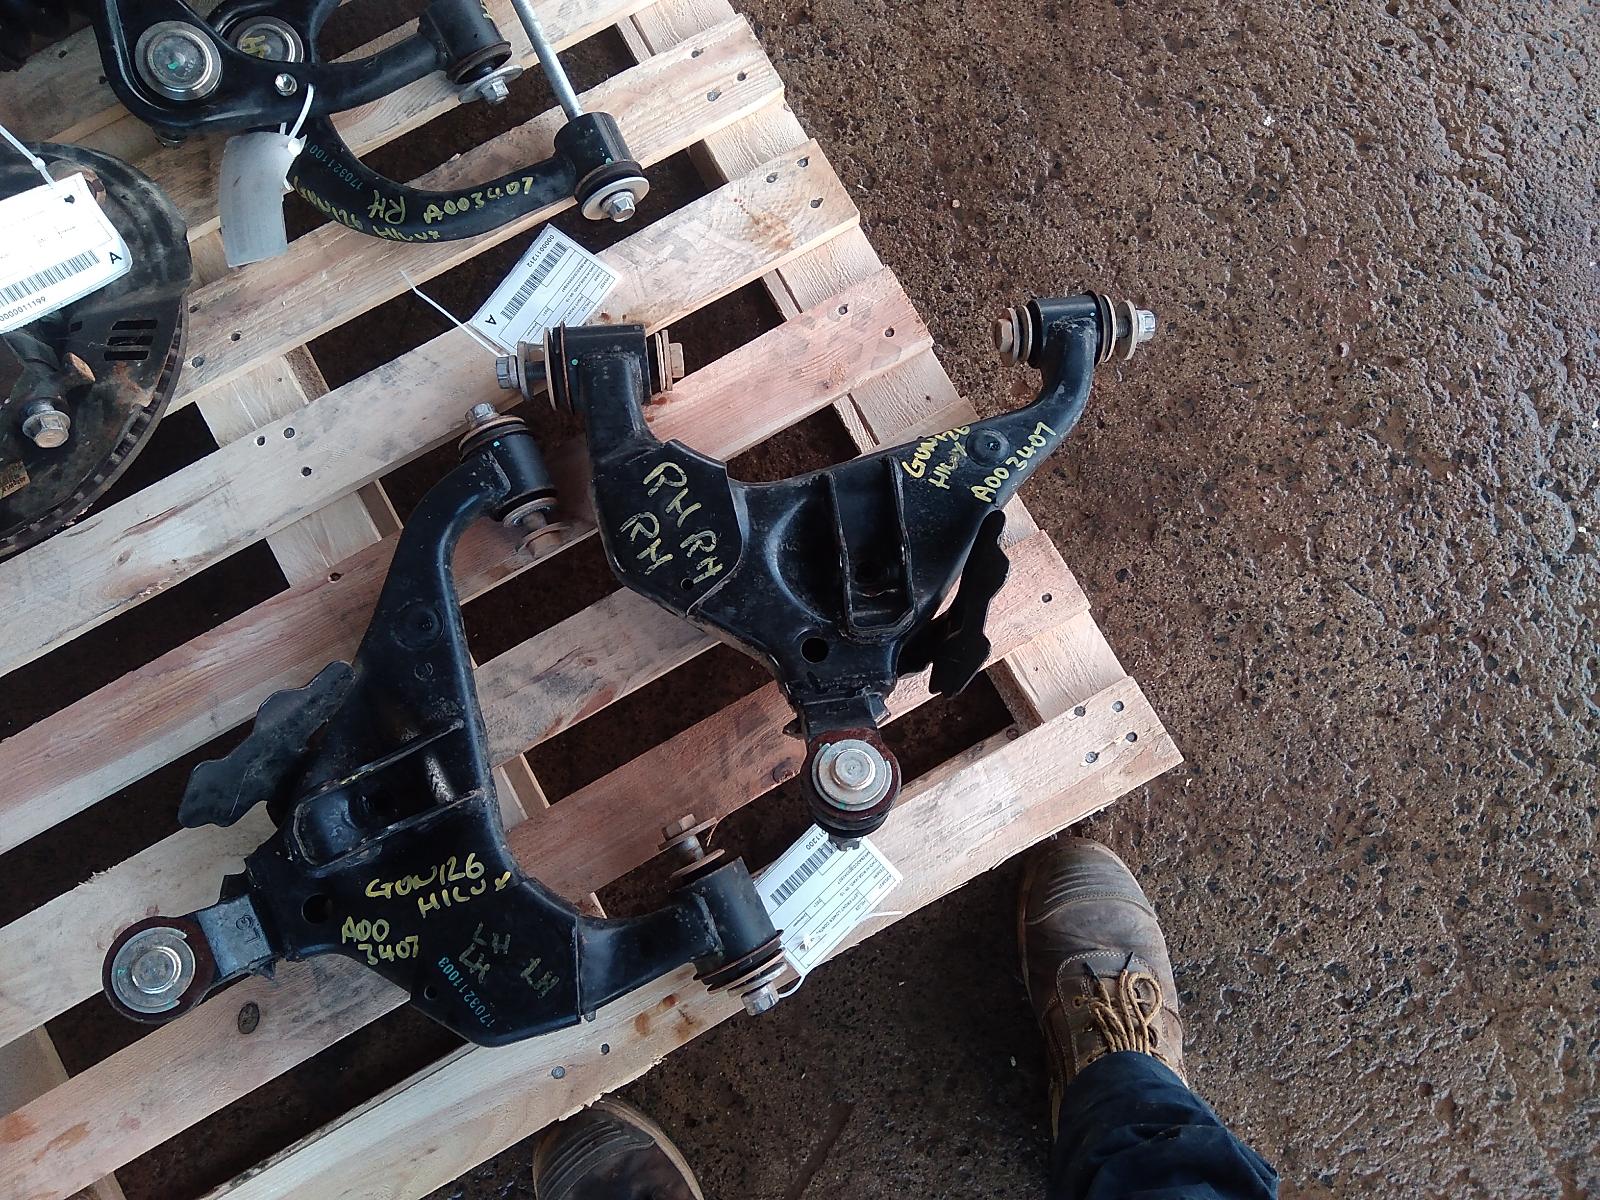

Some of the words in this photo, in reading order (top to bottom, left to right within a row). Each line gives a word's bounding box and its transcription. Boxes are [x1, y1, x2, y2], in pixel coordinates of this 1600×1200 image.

[368, 189, 407, 225] RH
[423, 176, 534, 224] A003407
[109, 251, 122, 264] A
[528, 234, 555, 268] 0000011212
[485, 314, 497, 326] A
[971, 422, 1057, 503] A003407
[643, 461, 702, 528] RH
[619, 511, 674, 575] RH
[680, 530, 723, 584] RH
[341, 915, 390, 944] A00
[357, 934, 419, 966] 3407
[437, 956, 496, 1028] 1703211003
